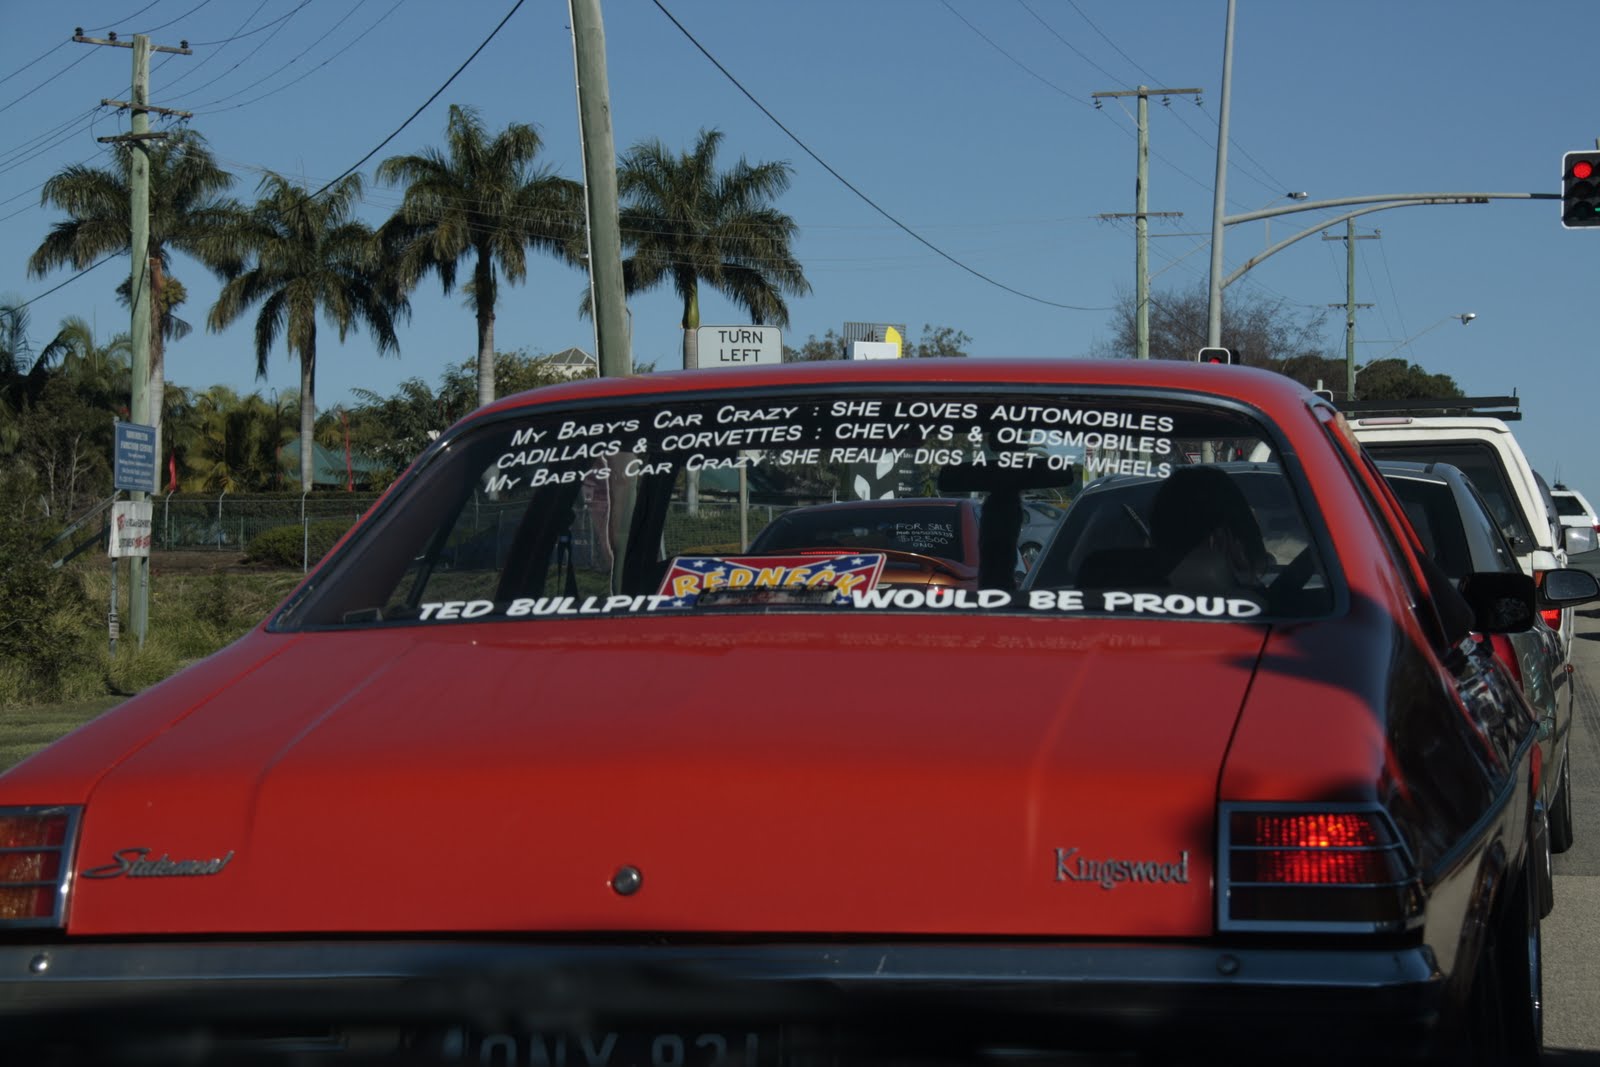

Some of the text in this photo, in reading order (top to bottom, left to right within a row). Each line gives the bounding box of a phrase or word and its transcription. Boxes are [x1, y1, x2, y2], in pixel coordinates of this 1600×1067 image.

[718, 330, 763, 344] TURN
[720, 349, 761, 362] LEFT
[511, 428, 547, 447] MY
[557, 419, 640, 441] BABY'S
[653, 411, 702, 429] CAR
[716, 405, 798, 424] CRAZY
[830, 401, 882, 417] SHE
[894, 402, 978, 419] LOVES
[990, 405, 1174, 432] AUTOMOBILES
[496, 439, 621, 469] CADILLACS
[632, 437, 648, 453] &
[661, 425, 802, 451] CORVETTES
[967, 425, 983, 441] &
[997, 427, 1172, 455] OLDSMOBILES
[484, 475, 520, 493] MY
[530, 467, 611, 488] BABY'S
[625, 459, 673, 478] CAR
[686, 454, 766, 471] CRAZY
[779, 449, 820, 466] SHE
[830, 448, 903, 464] REALLY
[914, 449, 963, 466] DIGS
[972, 450, 987, 467] A
[997, 452, 1035, 469] SET
[1047, 454, 1075, 471] OF
[1086, 457, 1171, 479] WHEELS
[896, 523, 953, 532] FOR SALE
[673, 566, 866, 598] REDNECK
[419, 588, 1261, 621] TED BULLPIT WOULD BE PROUD
[1054, 847, 1190, 889] Kingswood
